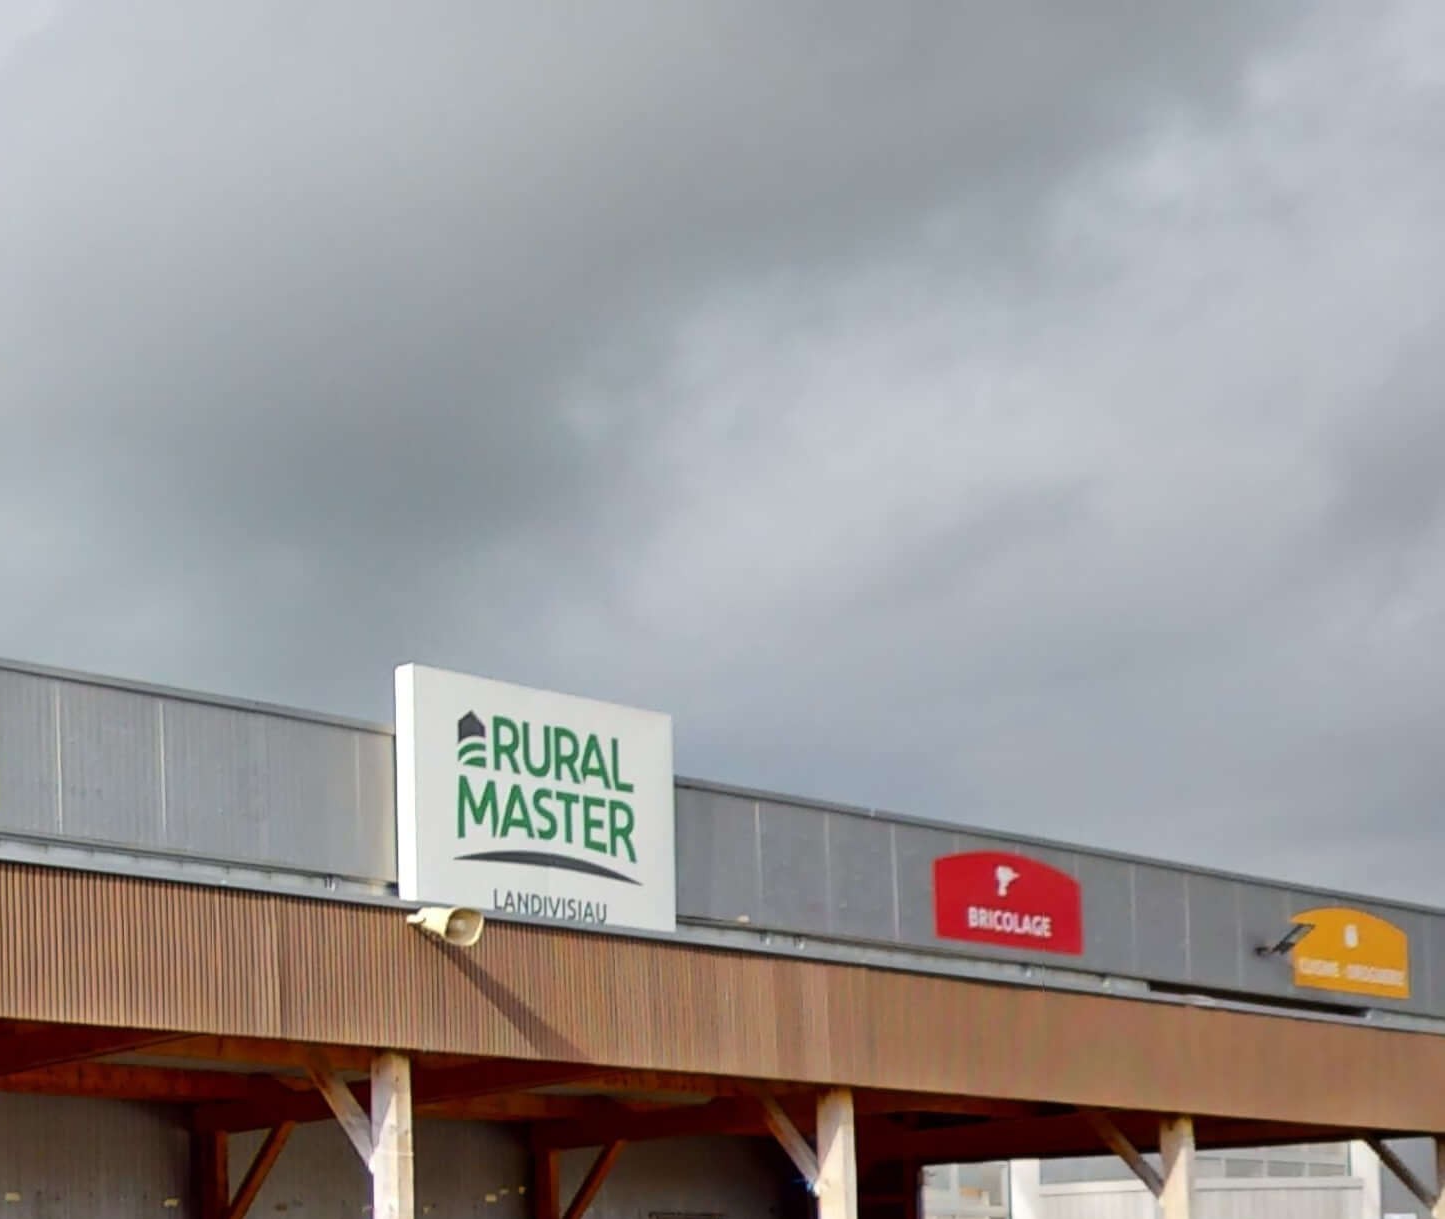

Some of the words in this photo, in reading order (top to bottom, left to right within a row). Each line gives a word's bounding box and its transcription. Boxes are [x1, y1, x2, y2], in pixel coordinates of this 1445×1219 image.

[492, 715, 634, 793] RURAL
[457, 774, 637, 863] MASTER
[493, 889, 607, 923] LANDIVISIAU
[967, 906, 1053, 938] BRICOLAGE
